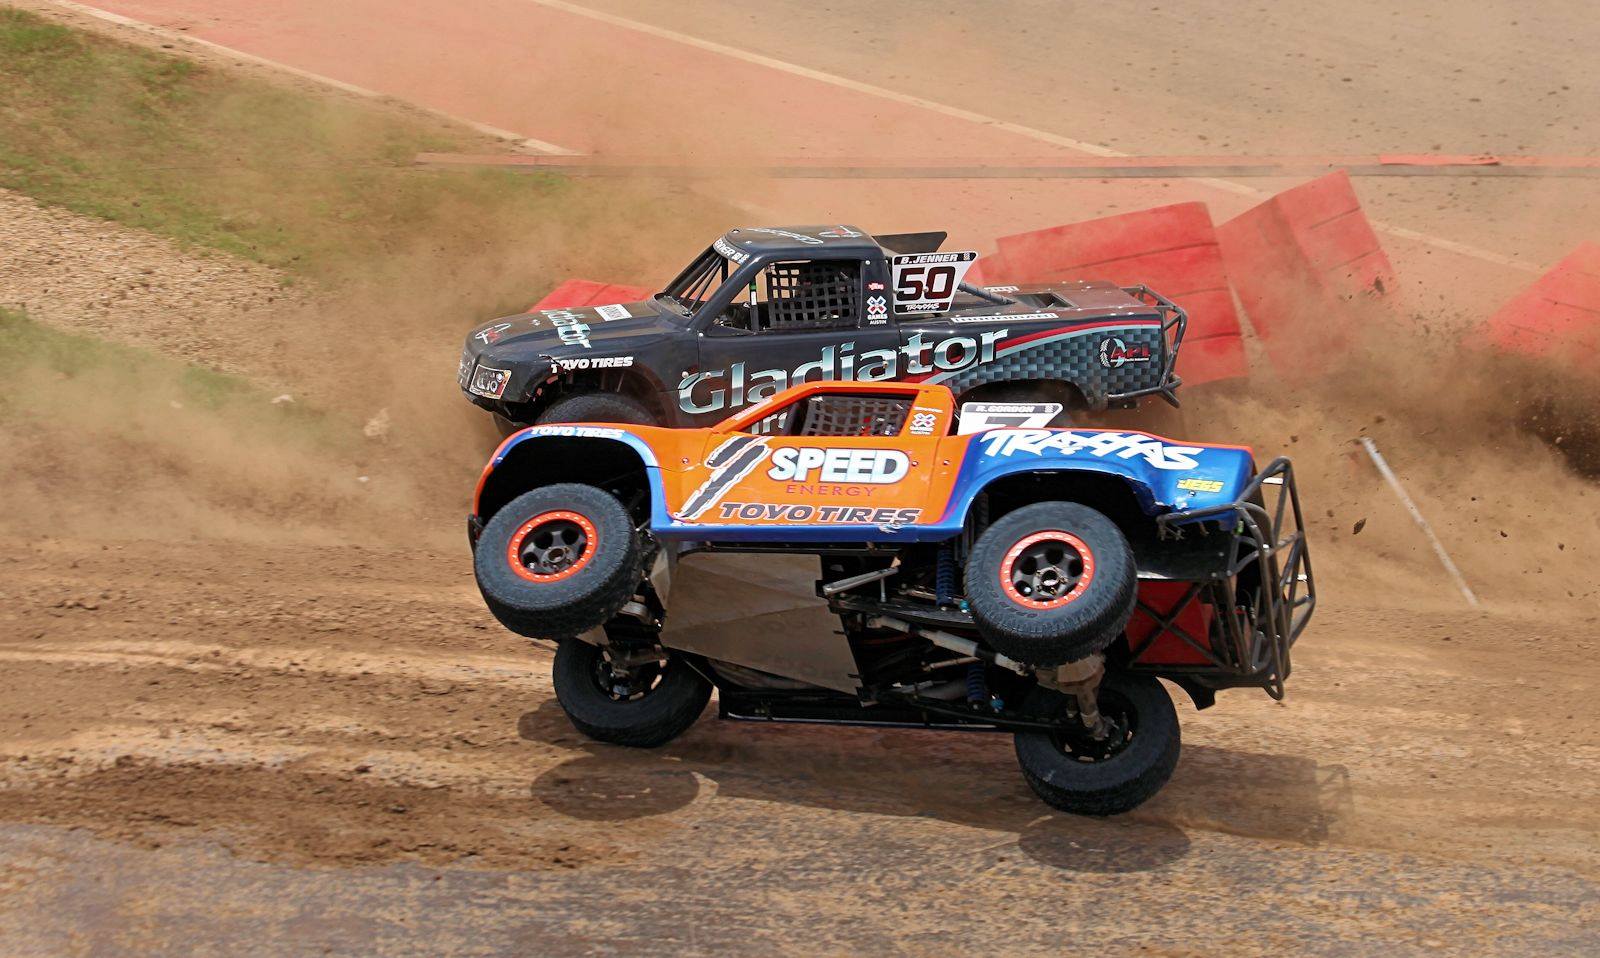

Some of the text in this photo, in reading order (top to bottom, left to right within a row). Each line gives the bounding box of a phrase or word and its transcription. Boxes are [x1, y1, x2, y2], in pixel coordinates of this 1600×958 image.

[900, 254, 959, 265] B.JENNER
[896, 266, 956, 301] 50
[591, 356, 634, 369] TIRES
[677, 328, 1009, 414] Gladiator
[976, 405, 1035, 413] R.GORDON
[531, 426, 626, 438] TOYO TIRES
[980, 429, 1204, 470] TRAXXAS
[767, 446, 911, 484] SPEED
[785, 484, 878, 497] ENERGY
[719, 502, 923, 524] TOYO TIRES
